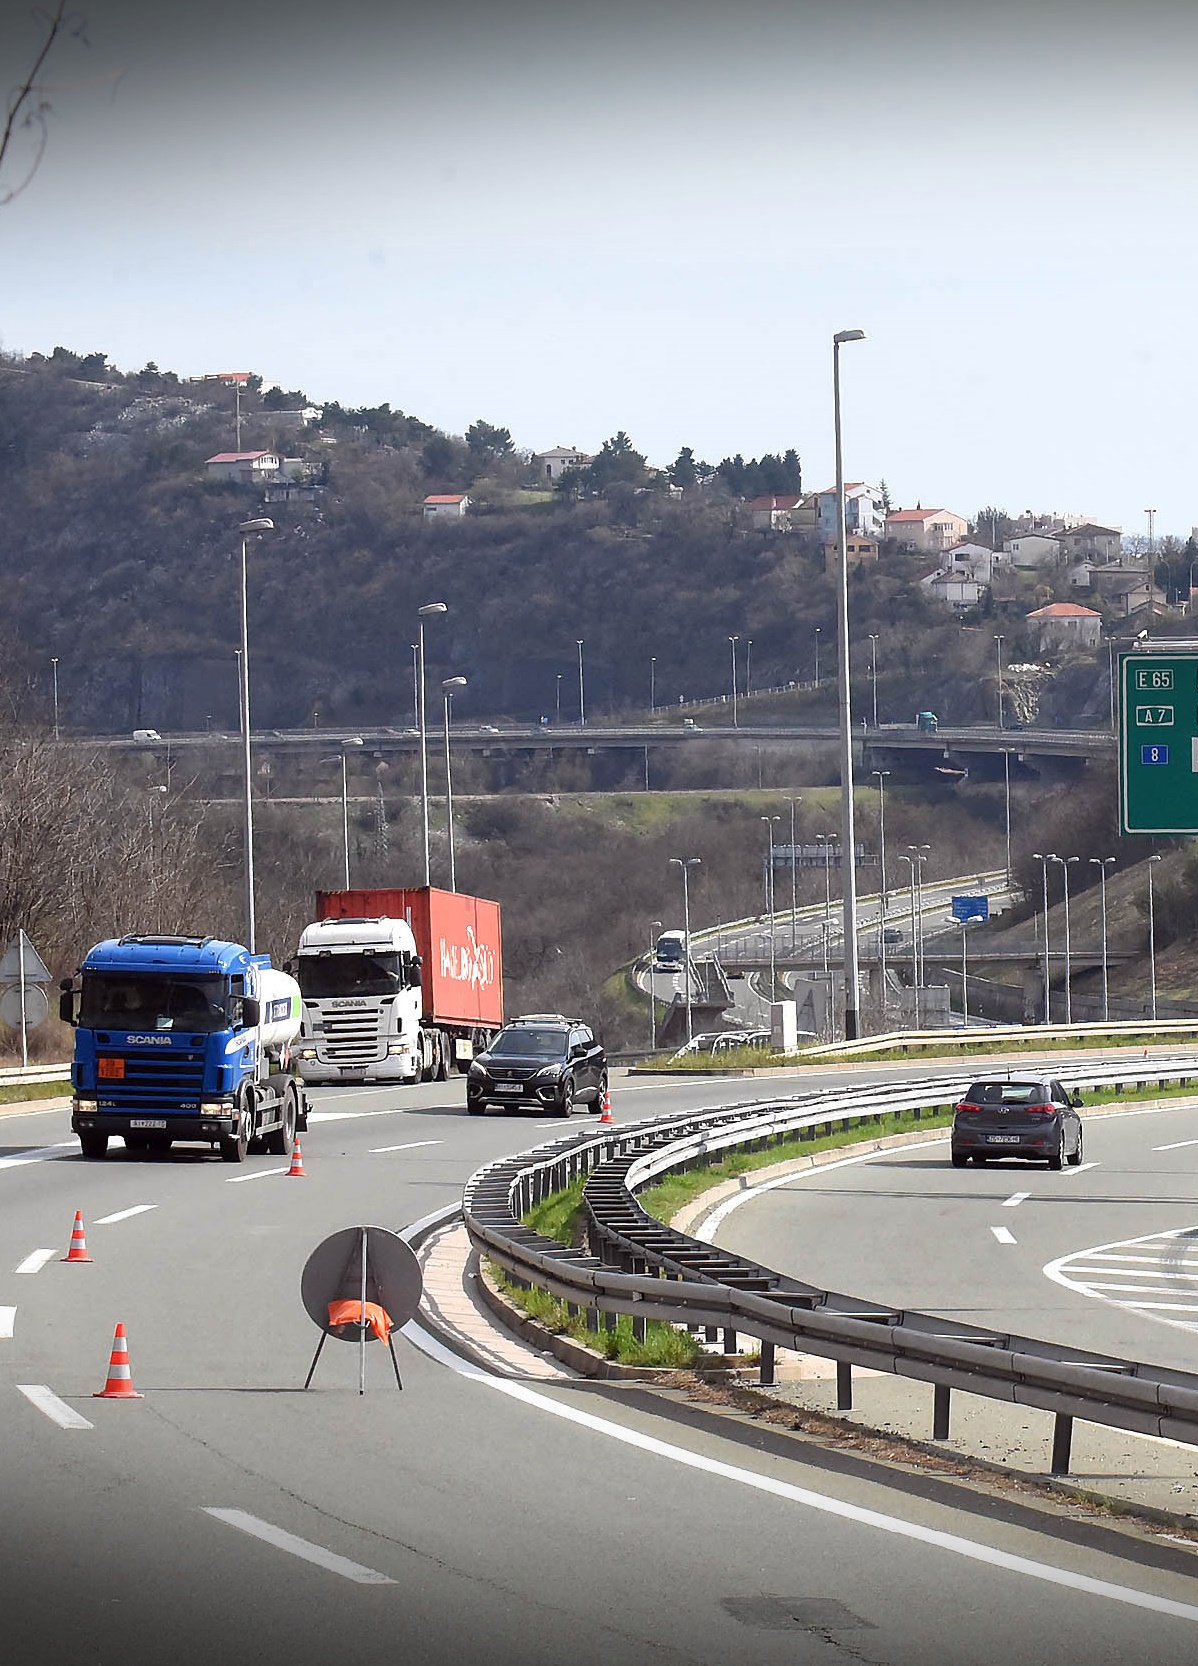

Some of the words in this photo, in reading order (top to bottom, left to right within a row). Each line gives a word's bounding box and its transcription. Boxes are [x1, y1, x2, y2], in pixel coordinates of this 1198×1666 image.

[1139, 673, 1147, 687] E
[1152, 672, 1170, 687] 65
[1144, 710, 1153, 723] A
[1158, 709, 1166, 722] 7
[1150, 747, 1159, 762] 8
[331, 999, 367, 1008] SCANIA
[126, 1035, 172, 1045] SCANIA
